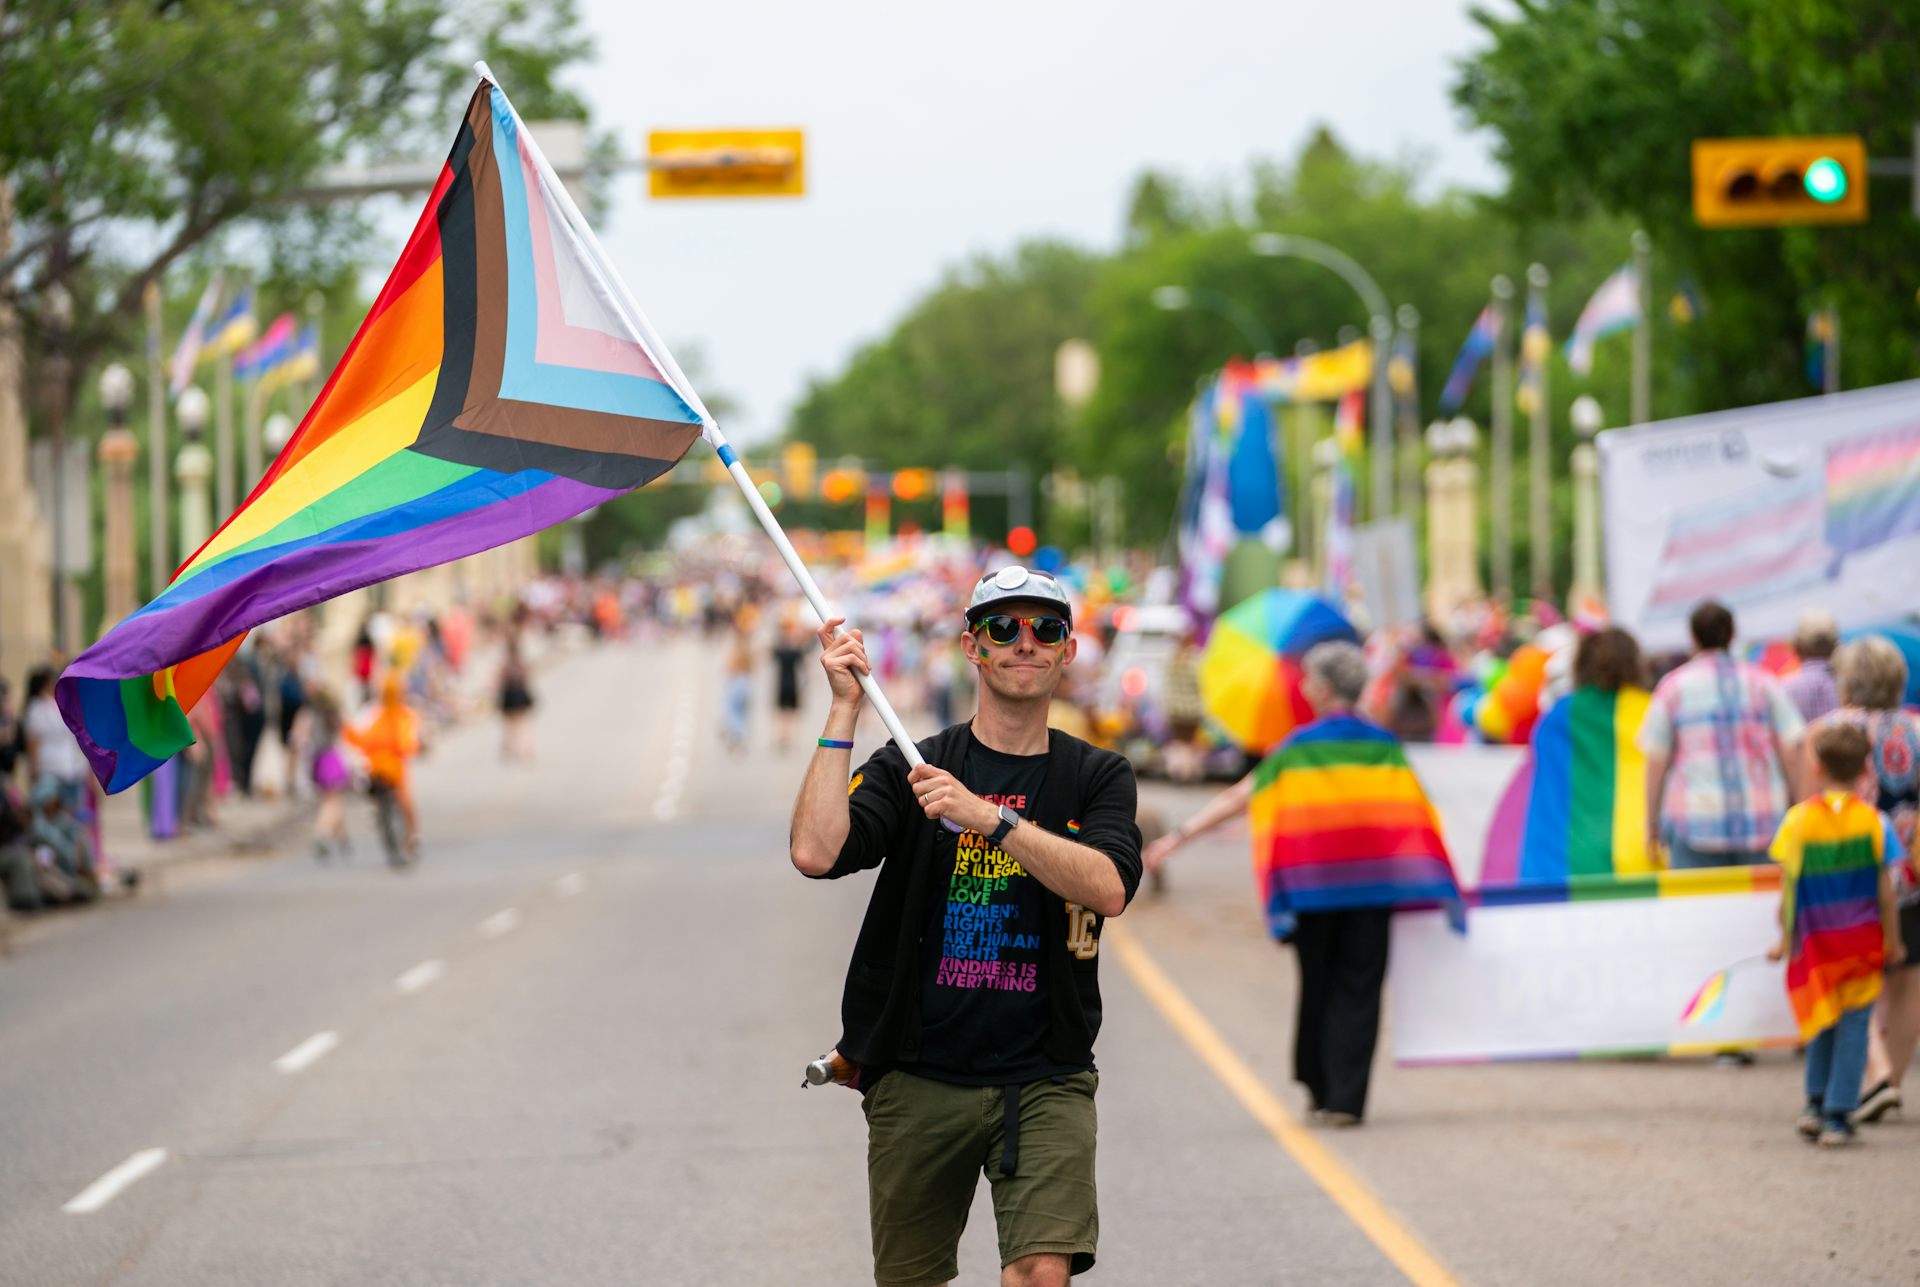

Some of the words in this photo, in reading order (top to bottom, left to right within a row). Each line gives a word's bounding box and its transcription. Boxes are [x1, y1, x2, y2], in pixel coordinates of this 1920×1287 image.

[956, 847, 982, 863] NO
[953, 861, 969, 875] IS
[950, 874, 993, 892] LOVE
[994, 876, 1008, 891] IS
[947, 888, 991, 906] LOVE
[946, 901, 1020, 919] WOMEN'S
[943, 915, 1003, 932] RIGHTS
[943, 929, 975, 945] ARE
[978, 932, 1040, 950] HUMAN
[942, 943, 999, 961] RIGHTS
[940, 956, 1017, 976] KINDNESS
[1021, 963, 1037, 977] IS
[936, 970, 1037, 992] EVERYTHING
